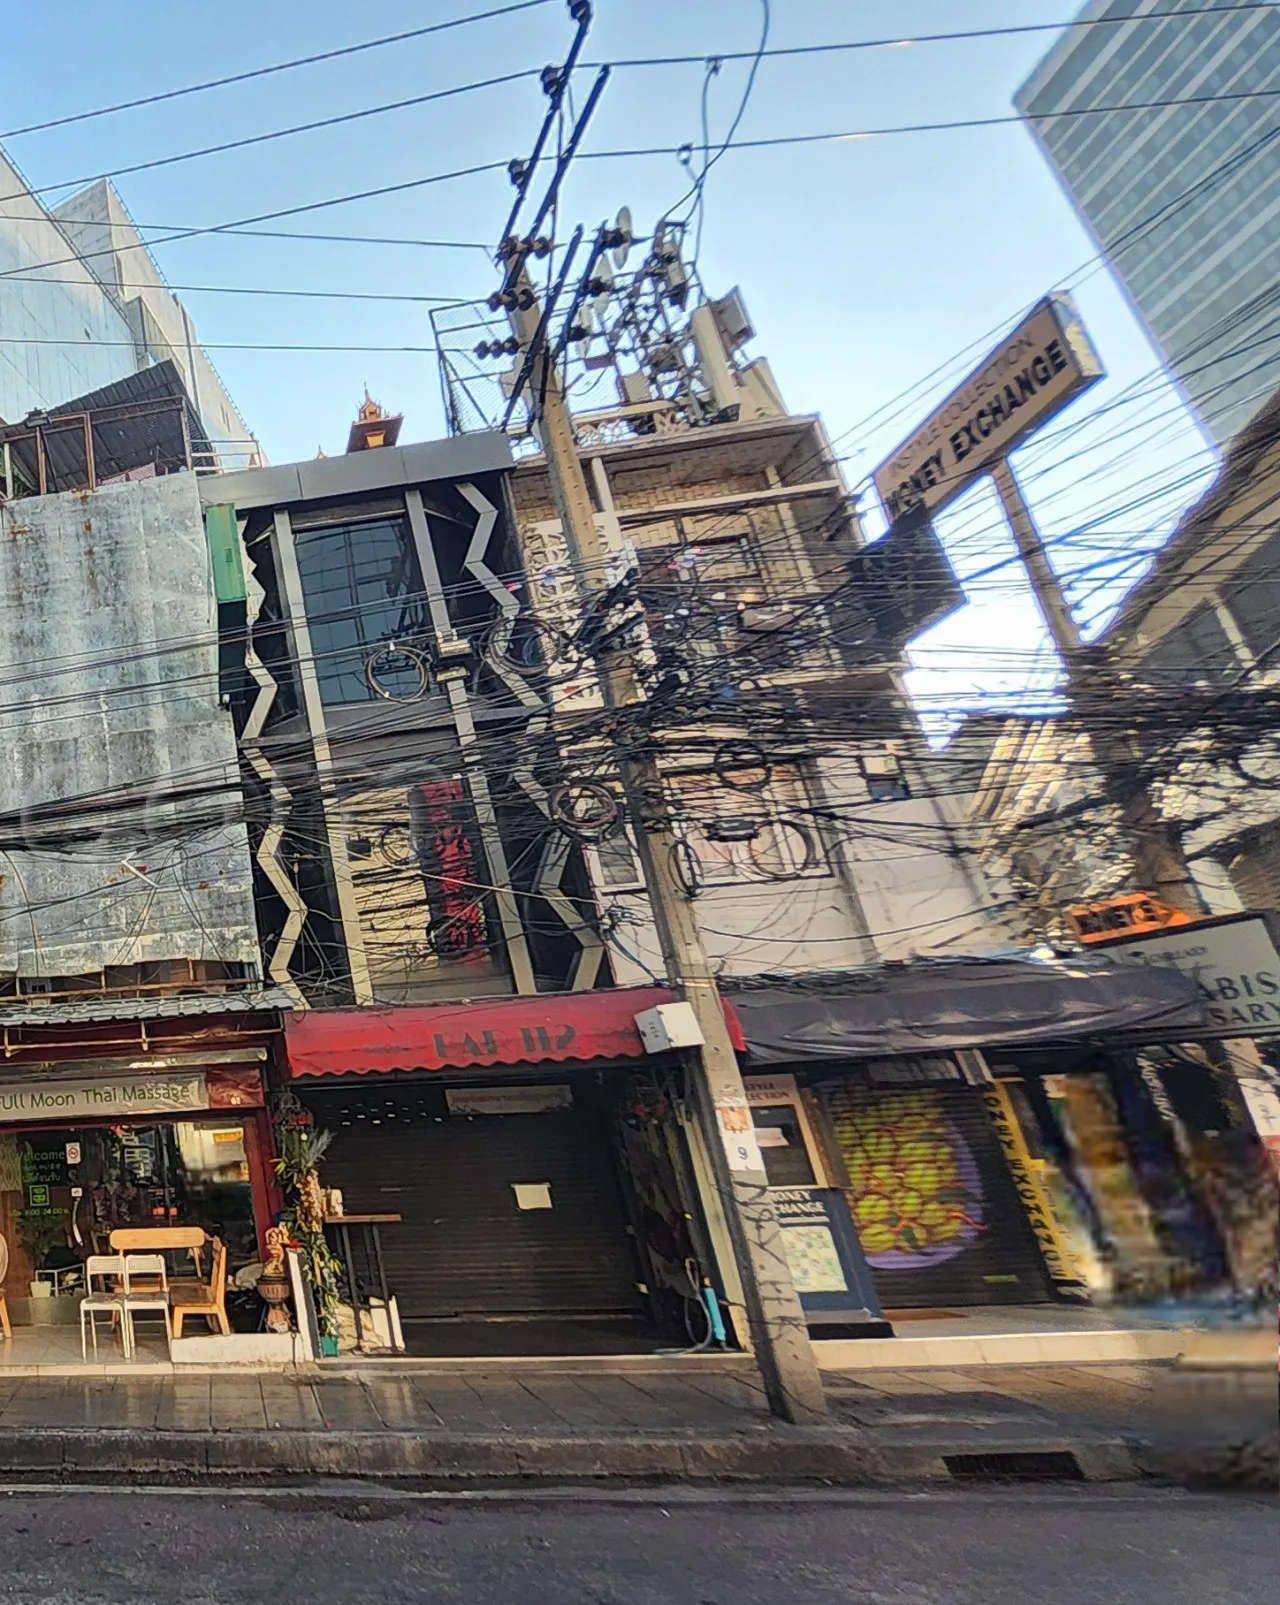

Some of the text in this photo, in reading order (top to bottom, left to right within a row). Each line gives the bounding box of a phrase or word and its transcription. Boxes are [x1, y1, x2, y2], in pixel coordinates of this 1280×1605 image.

[948, 338, 1069, 464] EXCHANGE
[519, 1023, 581, 1052] 112
[30, 1091, 76, 1109] Moon
[81, 1087, 118, 1104] Thai
[122, 1084, 191, 1104] Massage
